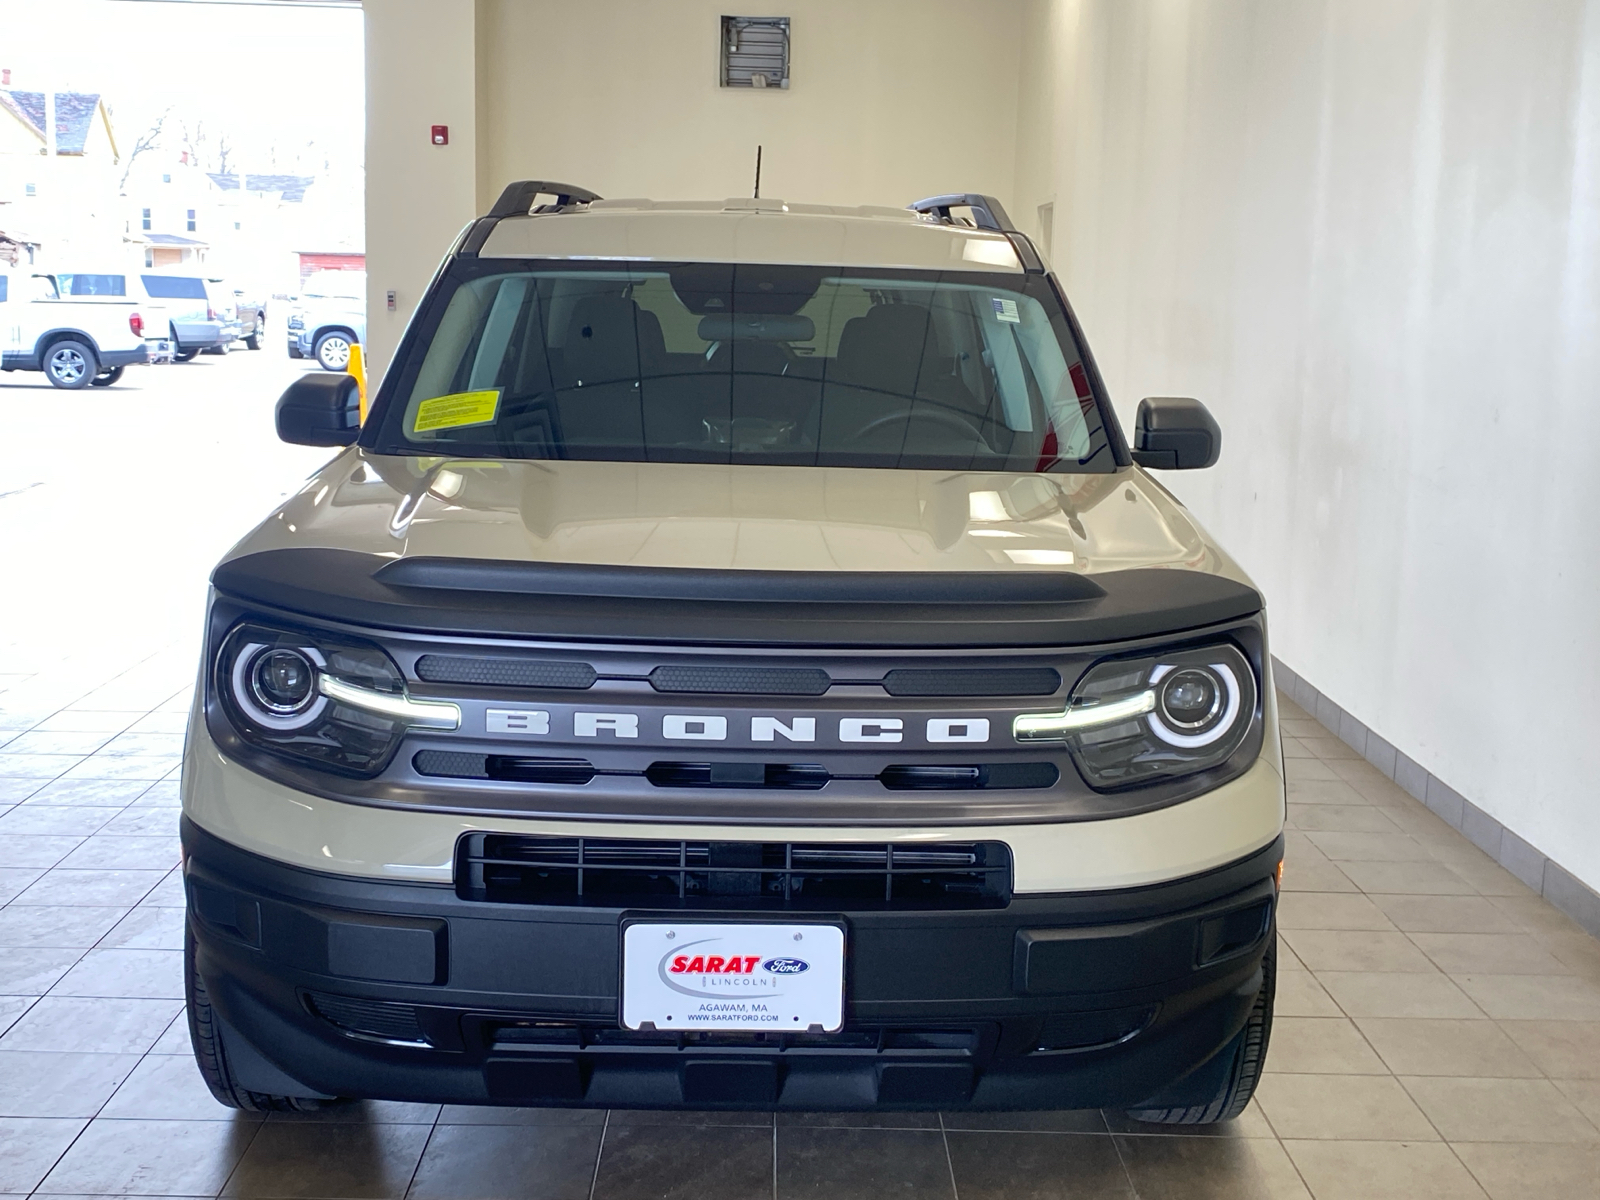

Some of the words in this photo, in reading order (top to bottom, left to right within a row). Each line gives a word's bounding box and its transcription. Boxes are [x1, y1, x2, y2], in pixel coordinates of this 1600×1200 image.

[485, 708, 991, 743] BRONCO
[670, 955, 761, 974] SARAT
[771, 960, 801, 973] Ford
[711, 978, 767, 986] LINCOLN
[699, 1003, 748, 1013] AGAWAM,
[751, 1003, 768, 1013] MA
[687, 1014, 779, 1022] WWW.SARATFORD.COM
